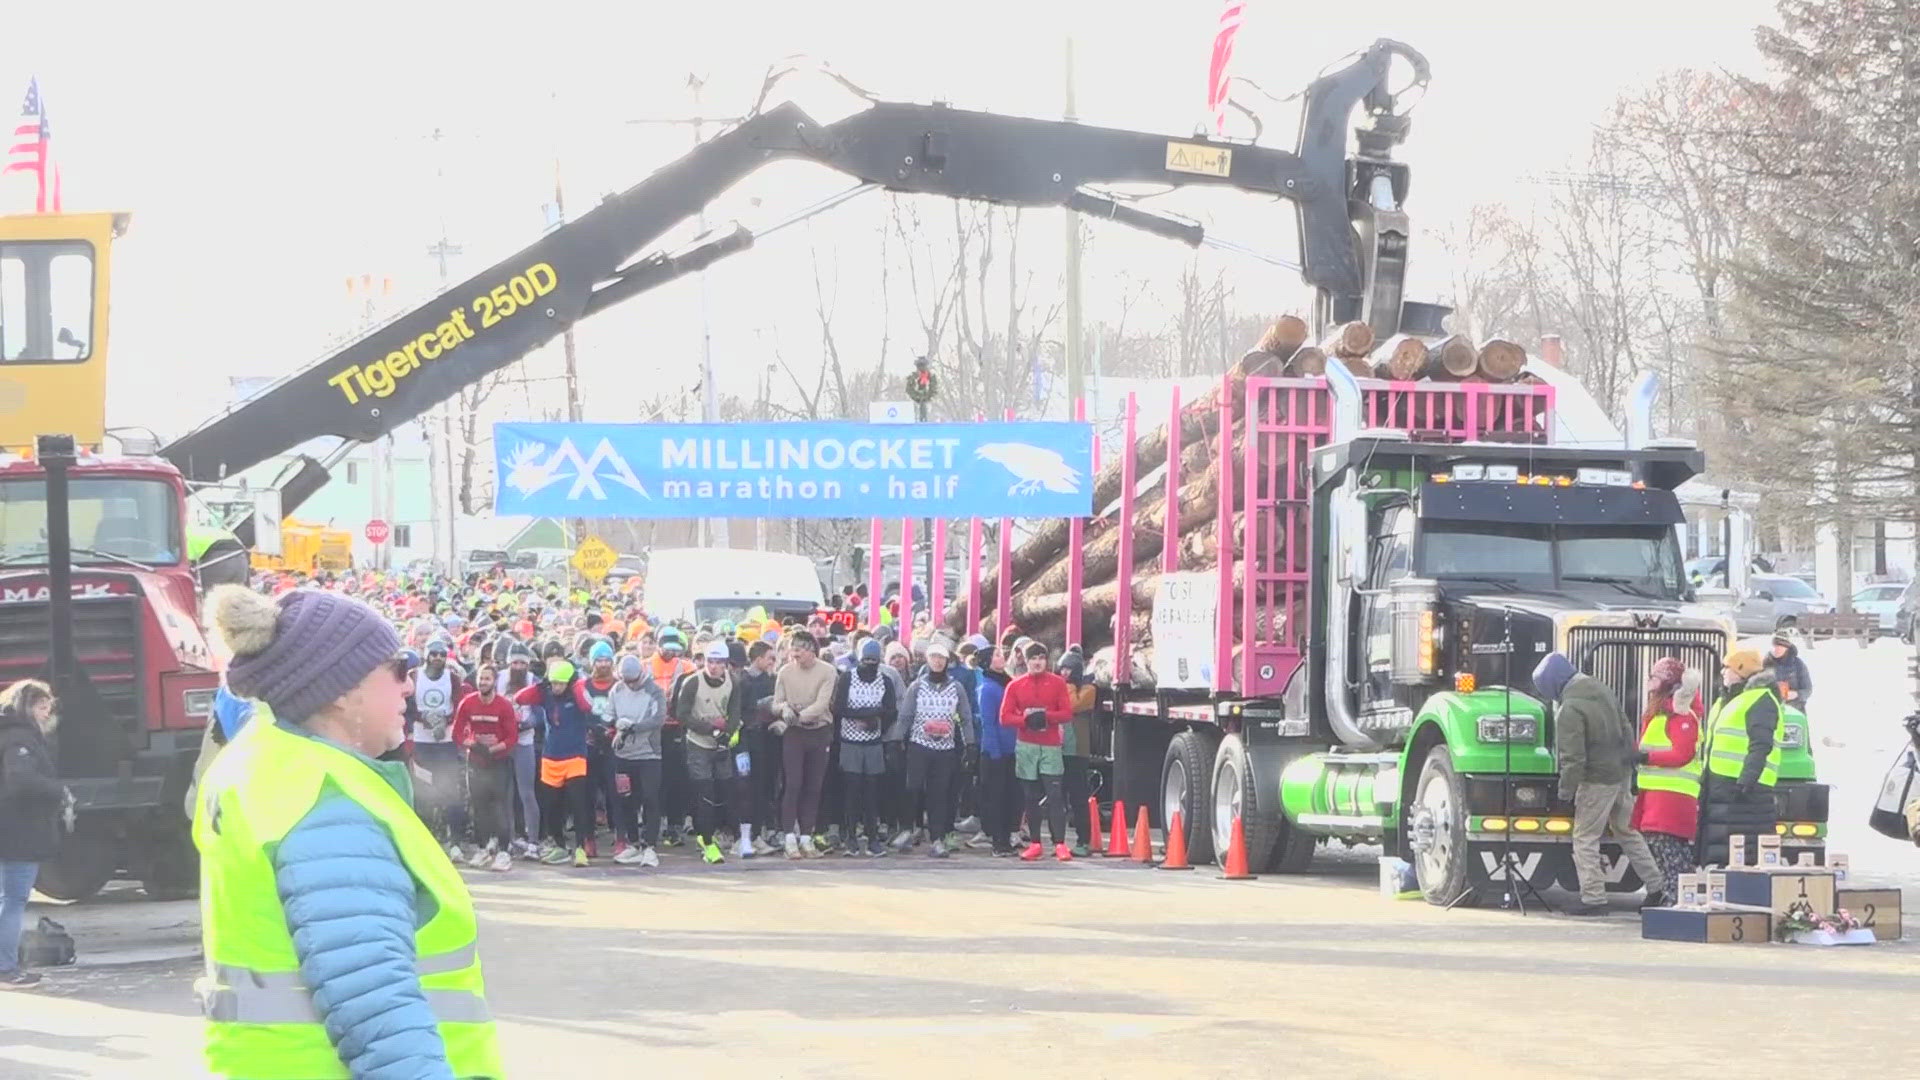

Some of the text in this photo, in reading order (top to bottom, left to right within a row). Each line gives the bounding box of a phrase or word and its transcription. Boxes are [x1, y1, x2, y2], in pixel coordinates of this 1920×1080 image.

[328, 262, 557, 405] Tigercat 250D
[661, 438, 961, 470] MILLINOCKET
[662, 475, 960, 499] marathon half
[367, 526, 388, 537] STOP
[583, 549, 605, 558] STOP
[584, 560, 608, 569] AHEAD
[1797, 877, 1808, 898] 1
[1863, 903, 1876, 927] 2
[1731, 916, 1744, 942] 3
